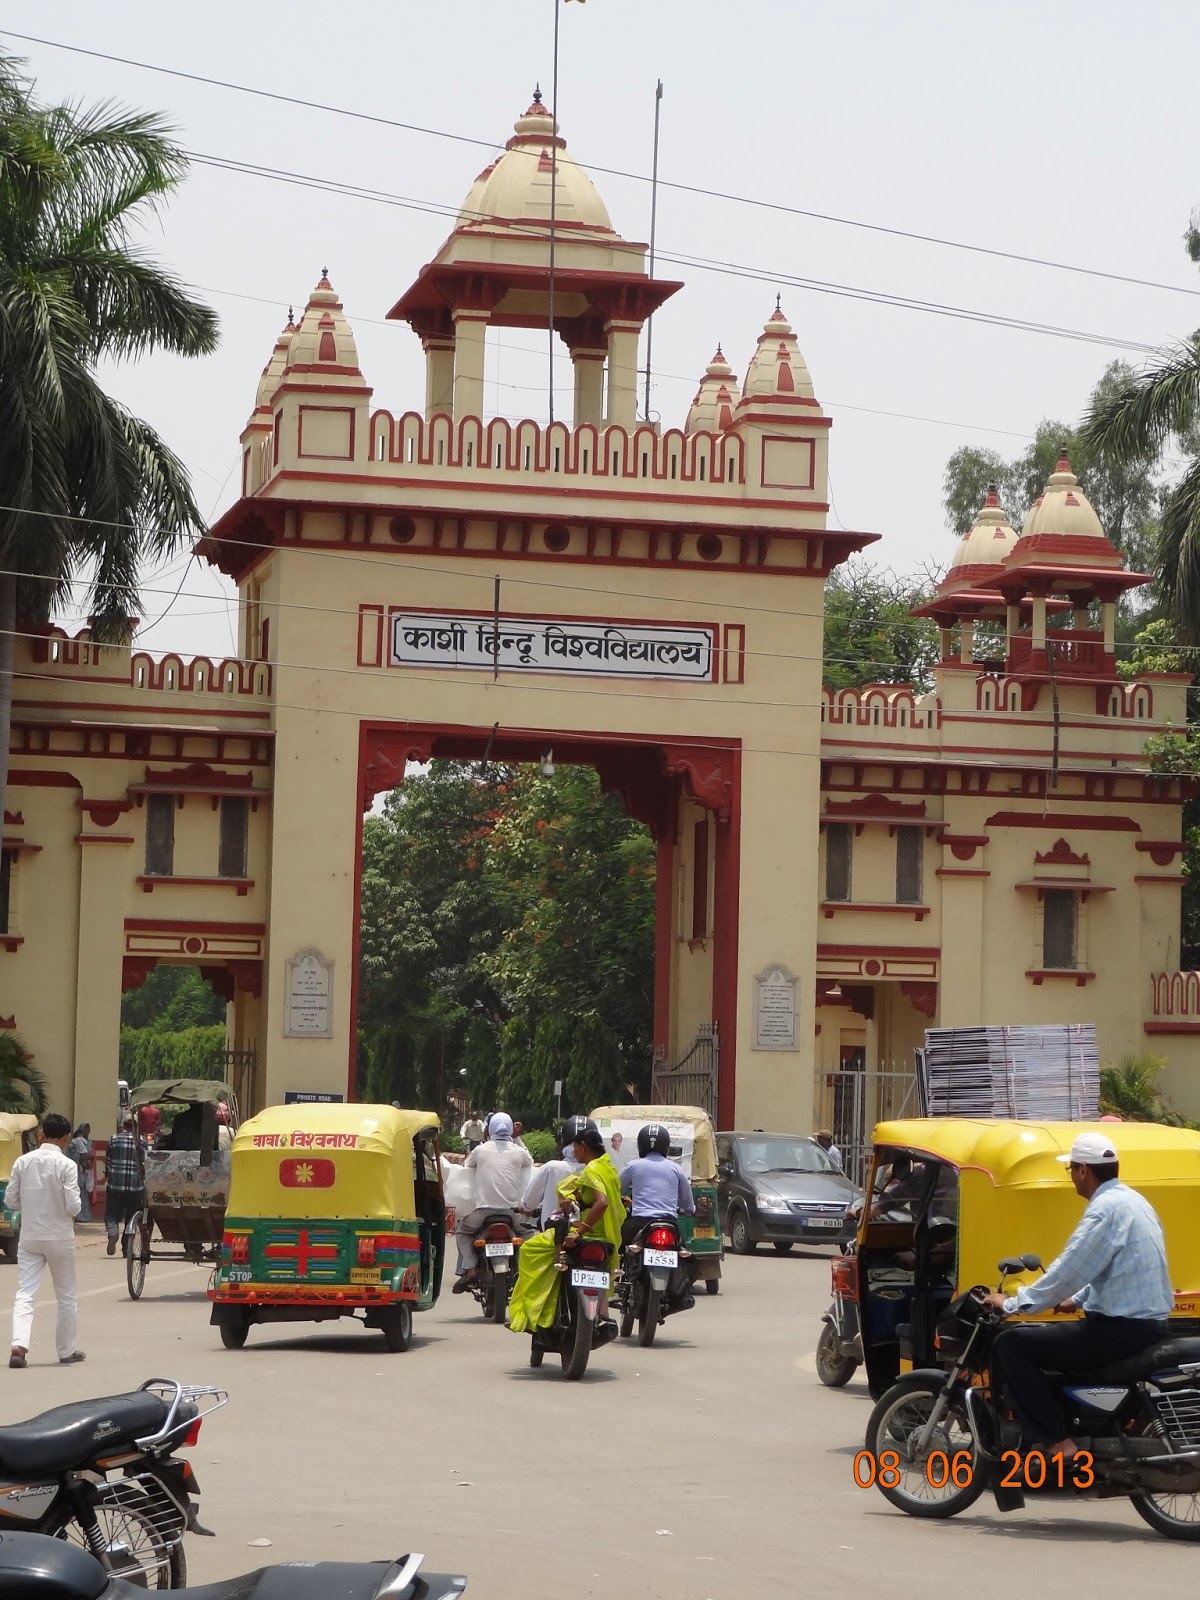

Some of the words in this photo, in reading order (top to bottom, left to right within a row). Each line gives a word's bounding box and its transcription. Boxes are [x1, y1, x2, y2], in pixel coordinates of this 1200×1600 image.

[402, 623, 467, 652] काशी
[476, 625, 538, 663] हिन्दू
[542, 627, 704, 665] विश्वविद्यालय
[253, 1134, 280, 1148] बाबा
[290, 1130, 360, 1150] विश्वनाथ
[647, 1256, 675, 1266] 4558
[229, 1271, 253, 1282] STOP
[573, 1272, 587, 1283] UP
